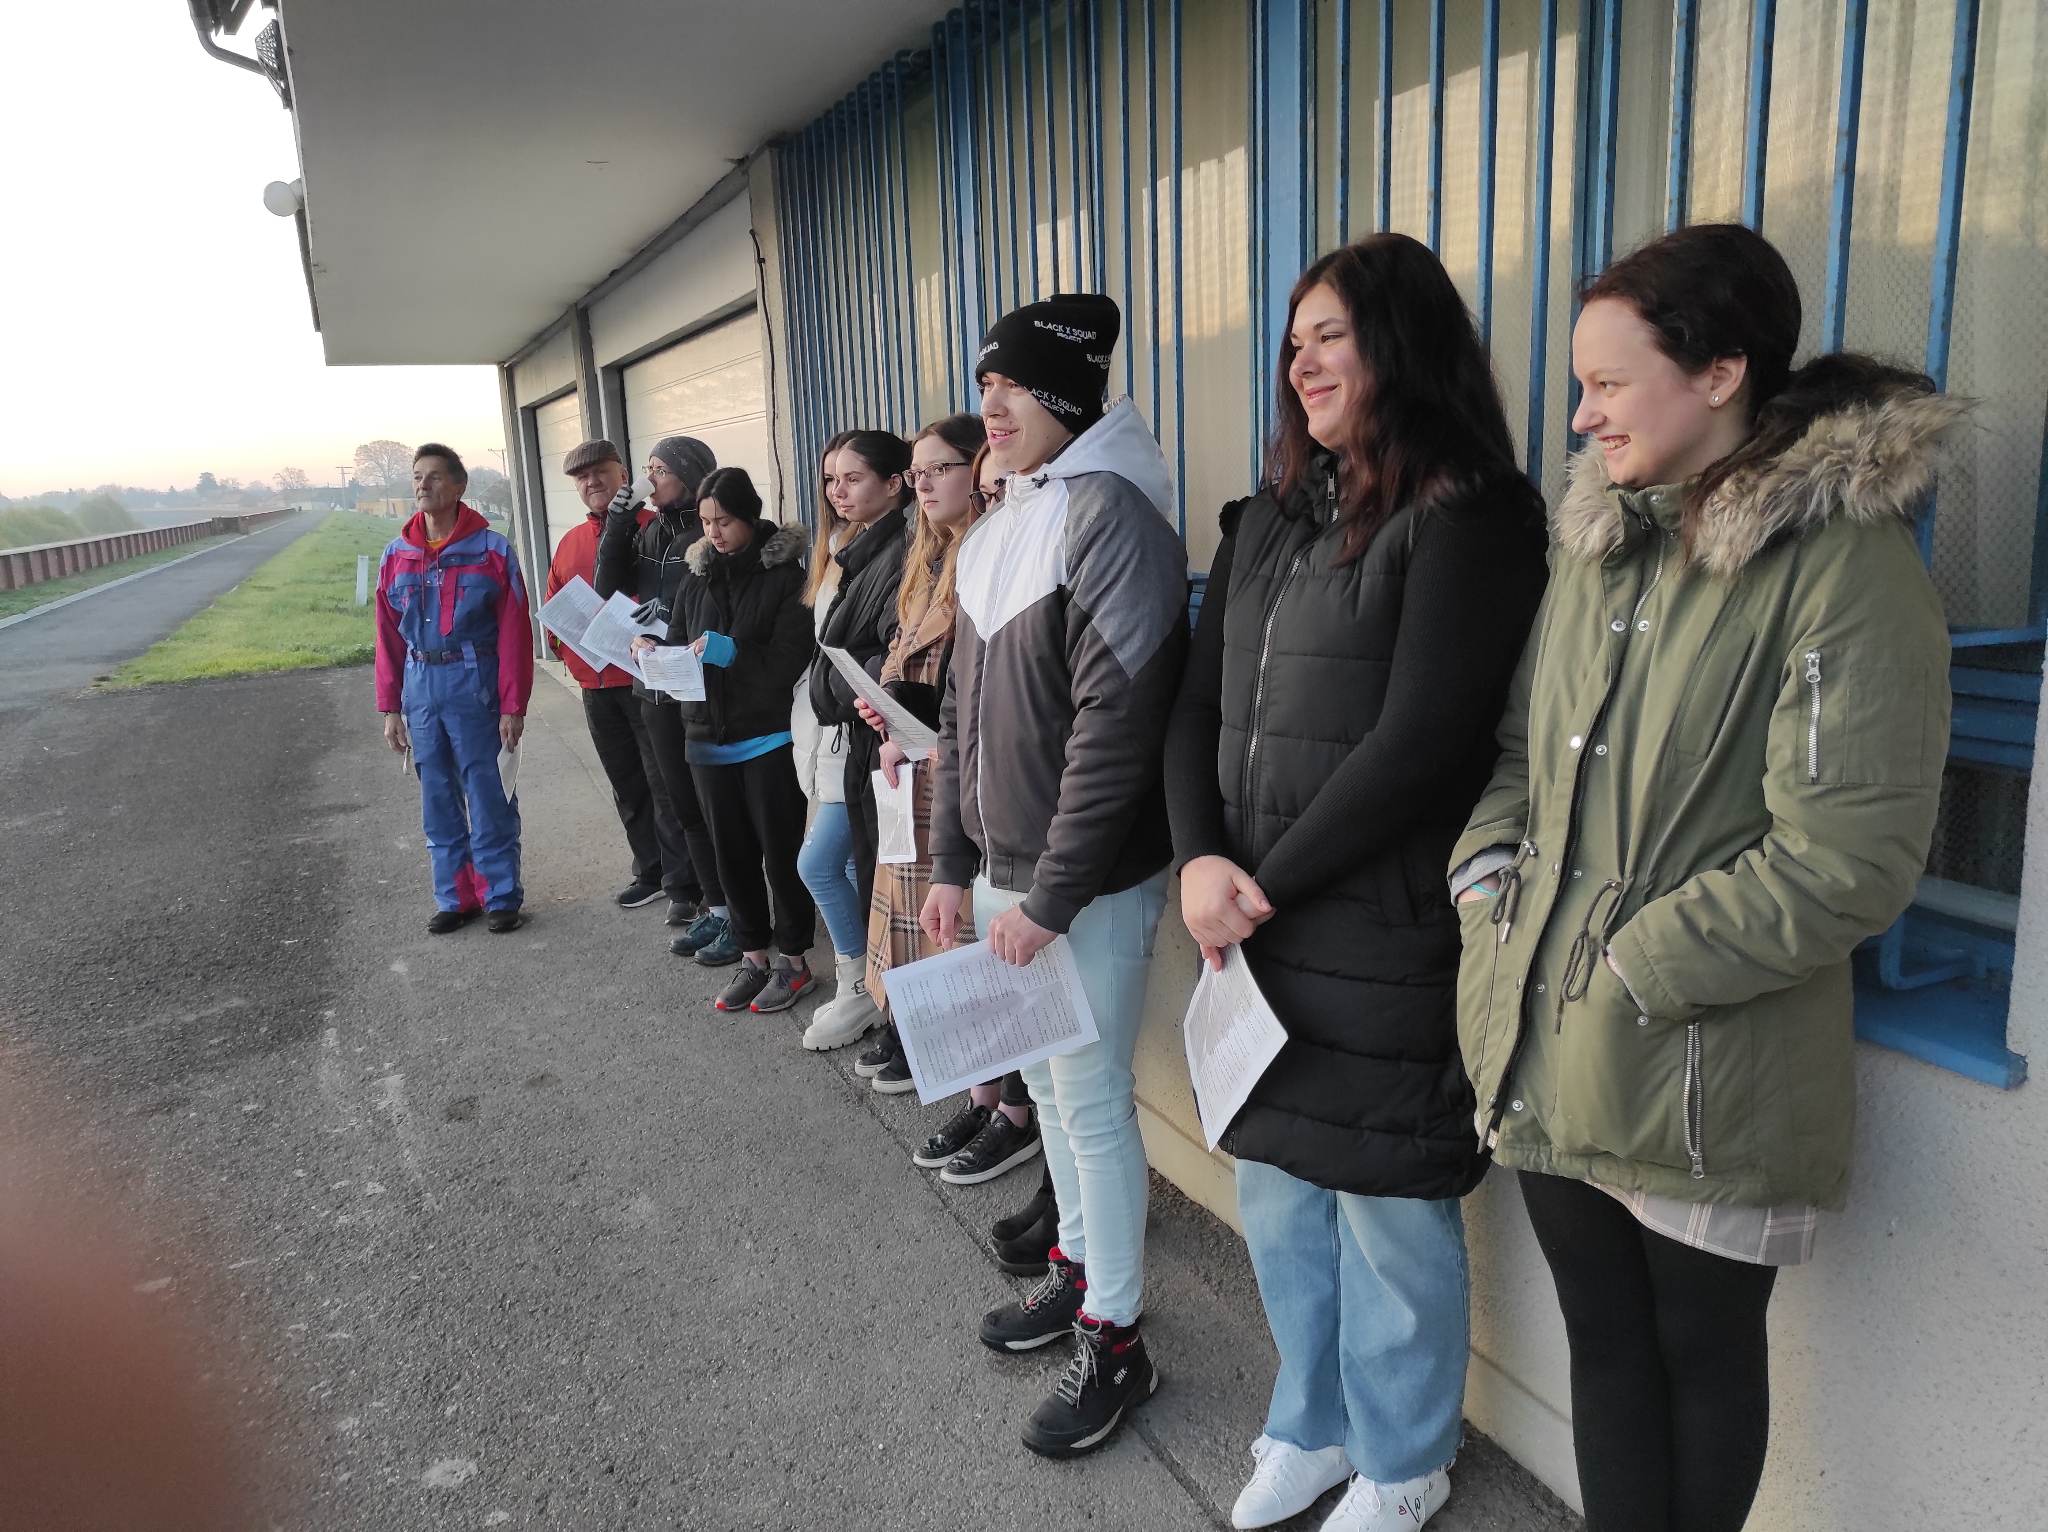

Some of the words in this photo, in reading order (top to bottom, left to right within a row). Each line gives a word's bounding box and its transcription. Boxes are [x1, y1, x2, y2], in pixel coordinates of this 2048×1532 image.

[1033, 320, 1064, 333] BLACK
[1065, 326, 1071, 335] X
[1072, 328, 1097, 340] SQUAD
[1023, 386, 1050, 401] LACK
[1050, 394, 1057, 404] X
[1057, 398, 1083, 415] SQUAD
